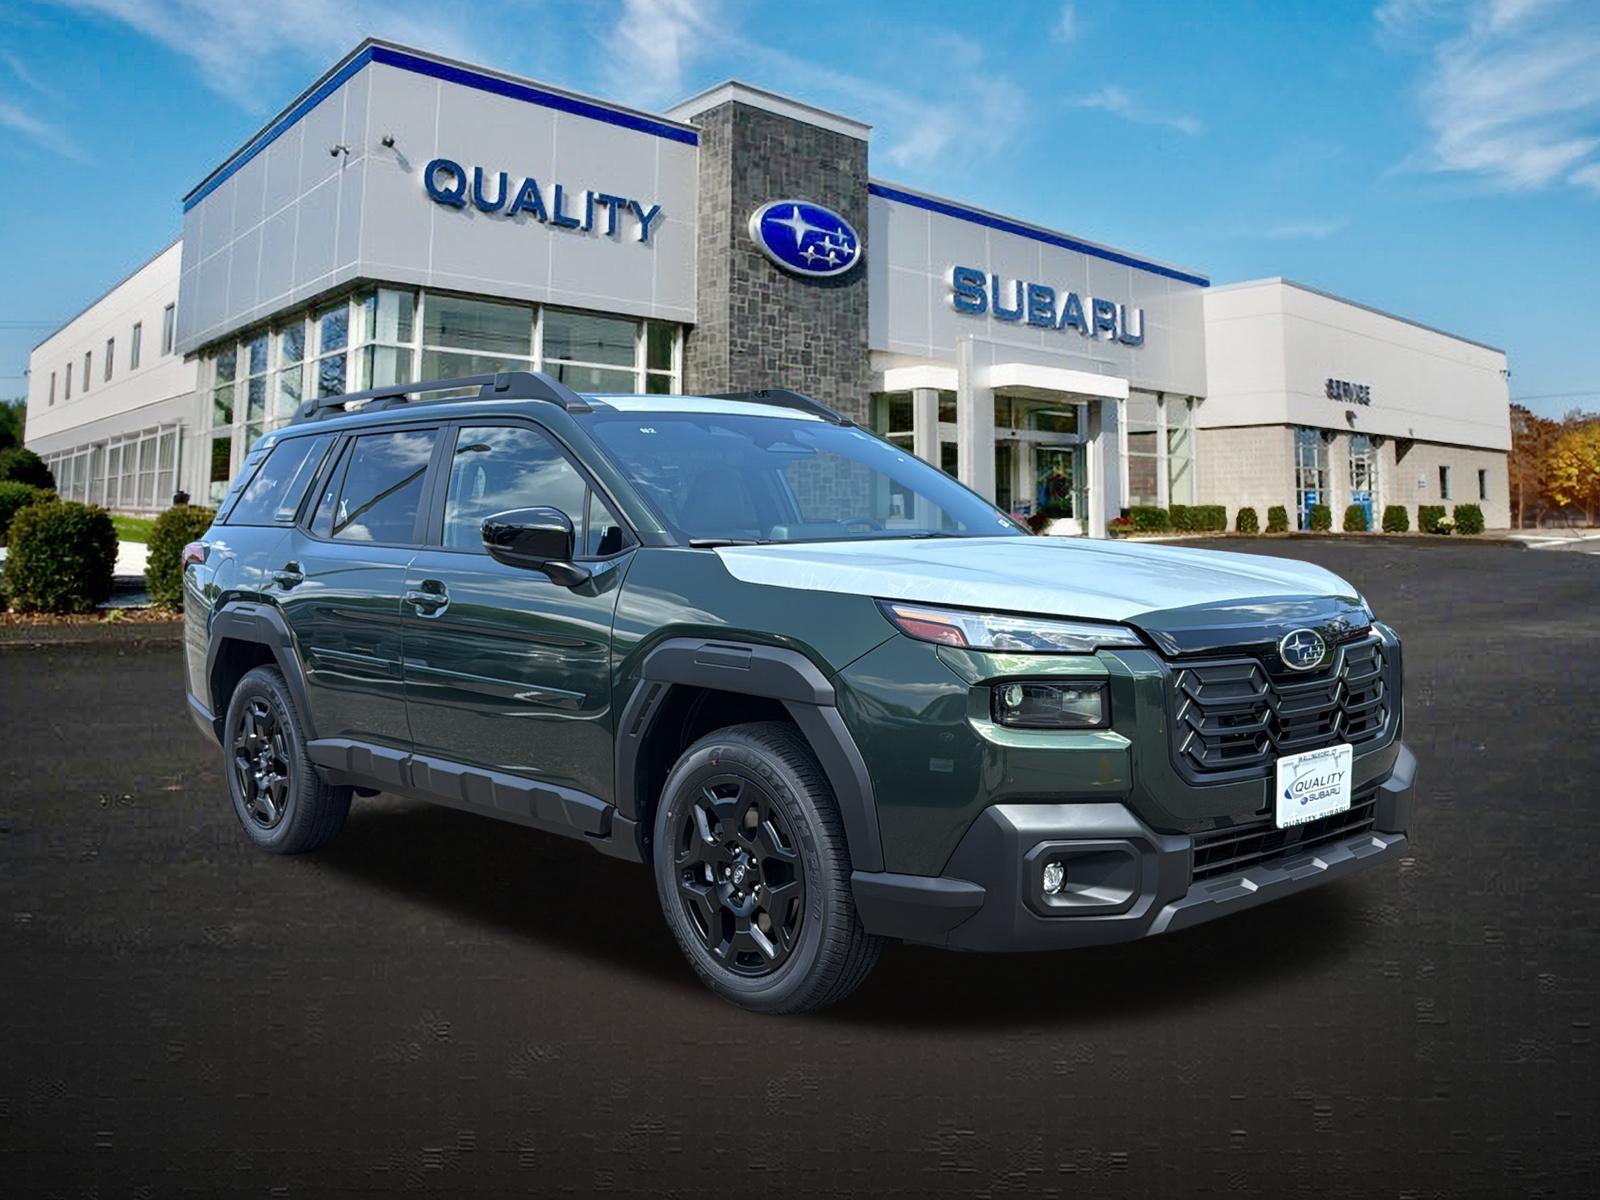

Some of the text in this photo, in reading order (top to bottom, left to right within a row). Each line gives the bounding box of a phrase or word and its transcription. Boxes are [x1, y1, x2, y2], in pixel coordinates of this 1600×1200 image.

[424, 158, 661, 243] QUALITY
[951, 266, 1145, 346] SUBARU
[1295, 771, 1345, 792] QUALITY
[1308, 788, 1341, 802] SUBARU
